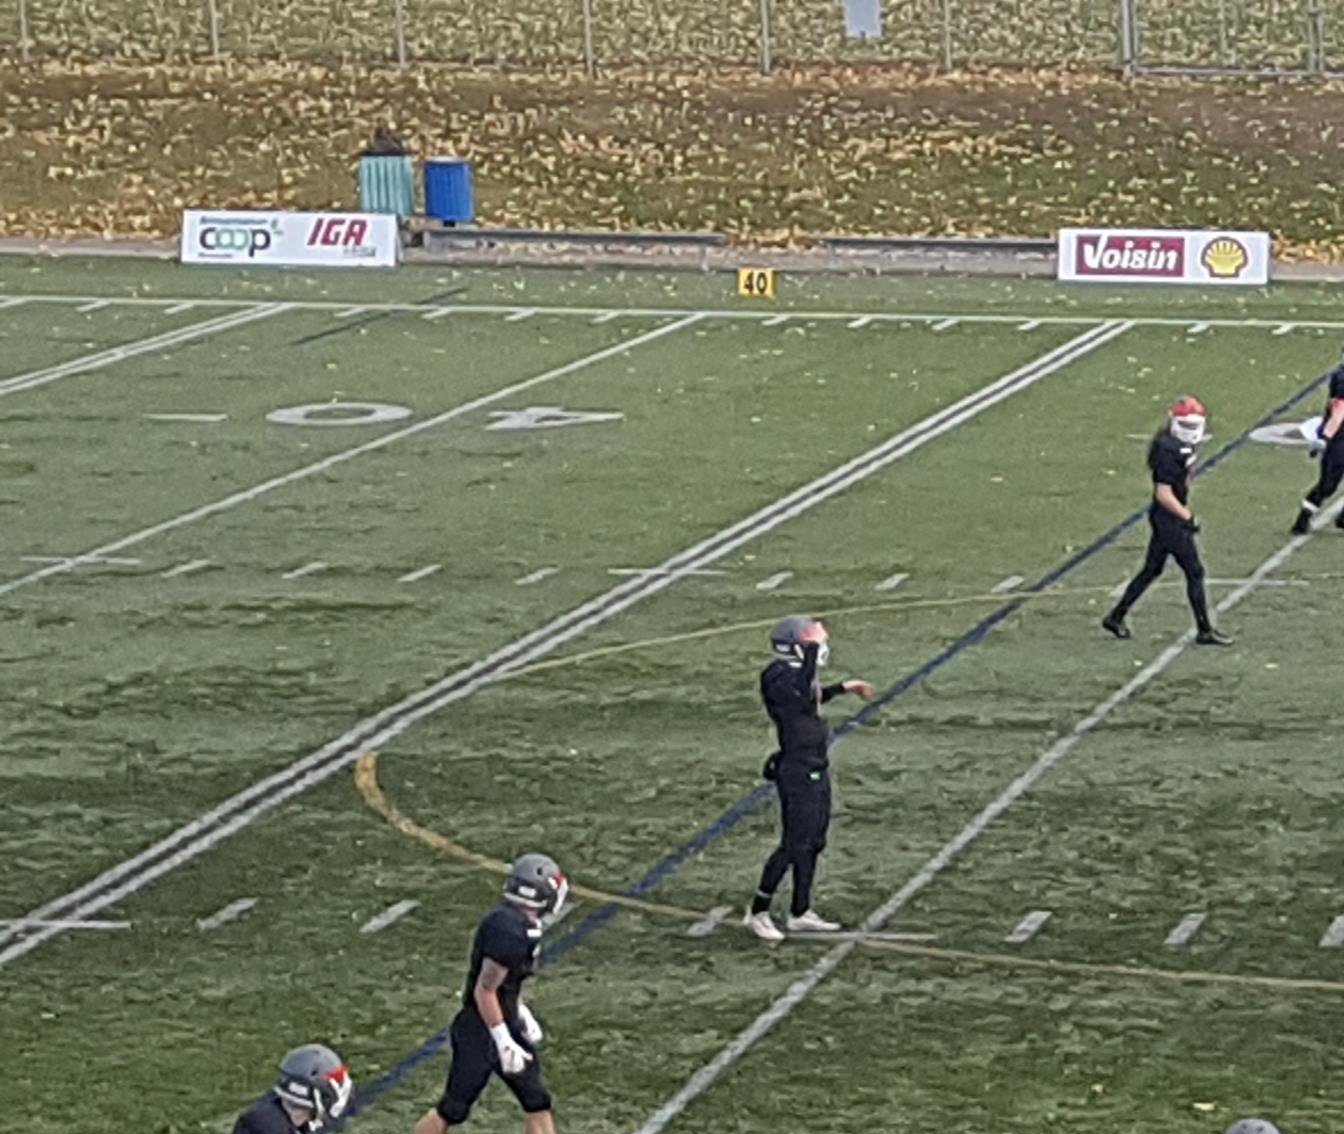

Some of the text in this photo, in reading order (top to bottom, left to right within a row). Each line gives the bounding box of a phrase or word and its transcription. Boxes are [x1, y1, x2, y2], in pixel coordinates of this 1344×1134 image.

[307, 218, 368, 246] IGA
[1084, 235, 1178, 270] Voisin
[743, 270, 768, 295] 40
